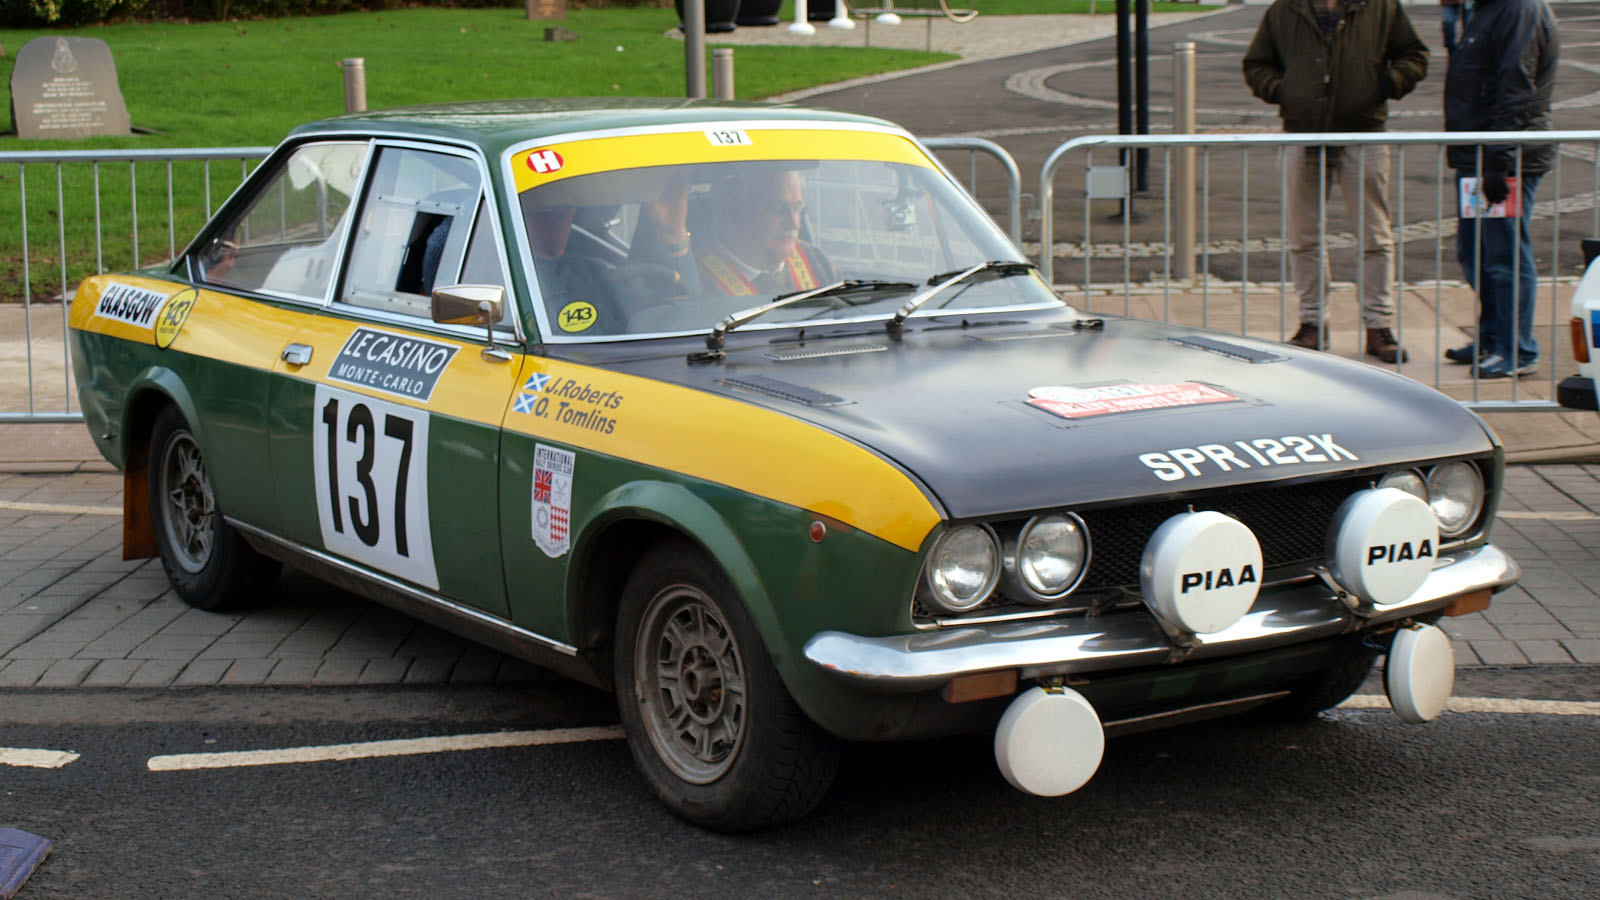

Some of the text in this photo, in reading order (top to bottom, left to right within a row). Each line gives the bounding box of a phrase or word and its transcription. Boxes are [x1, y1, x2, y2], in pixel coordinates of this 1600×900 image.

[712, 131, 742, 144] 137
[528, 150, 561, 173] H
[100, 285, 163, 324] GLASGOW
[562, 306, 593, 323] 143
[535, 397, 617, 435] O. Tomlins
[322, 397, 414, 558] 137
[1368, 539, 1433, 566] PIAA
[1181, 564, 1257, 594] PIAA
